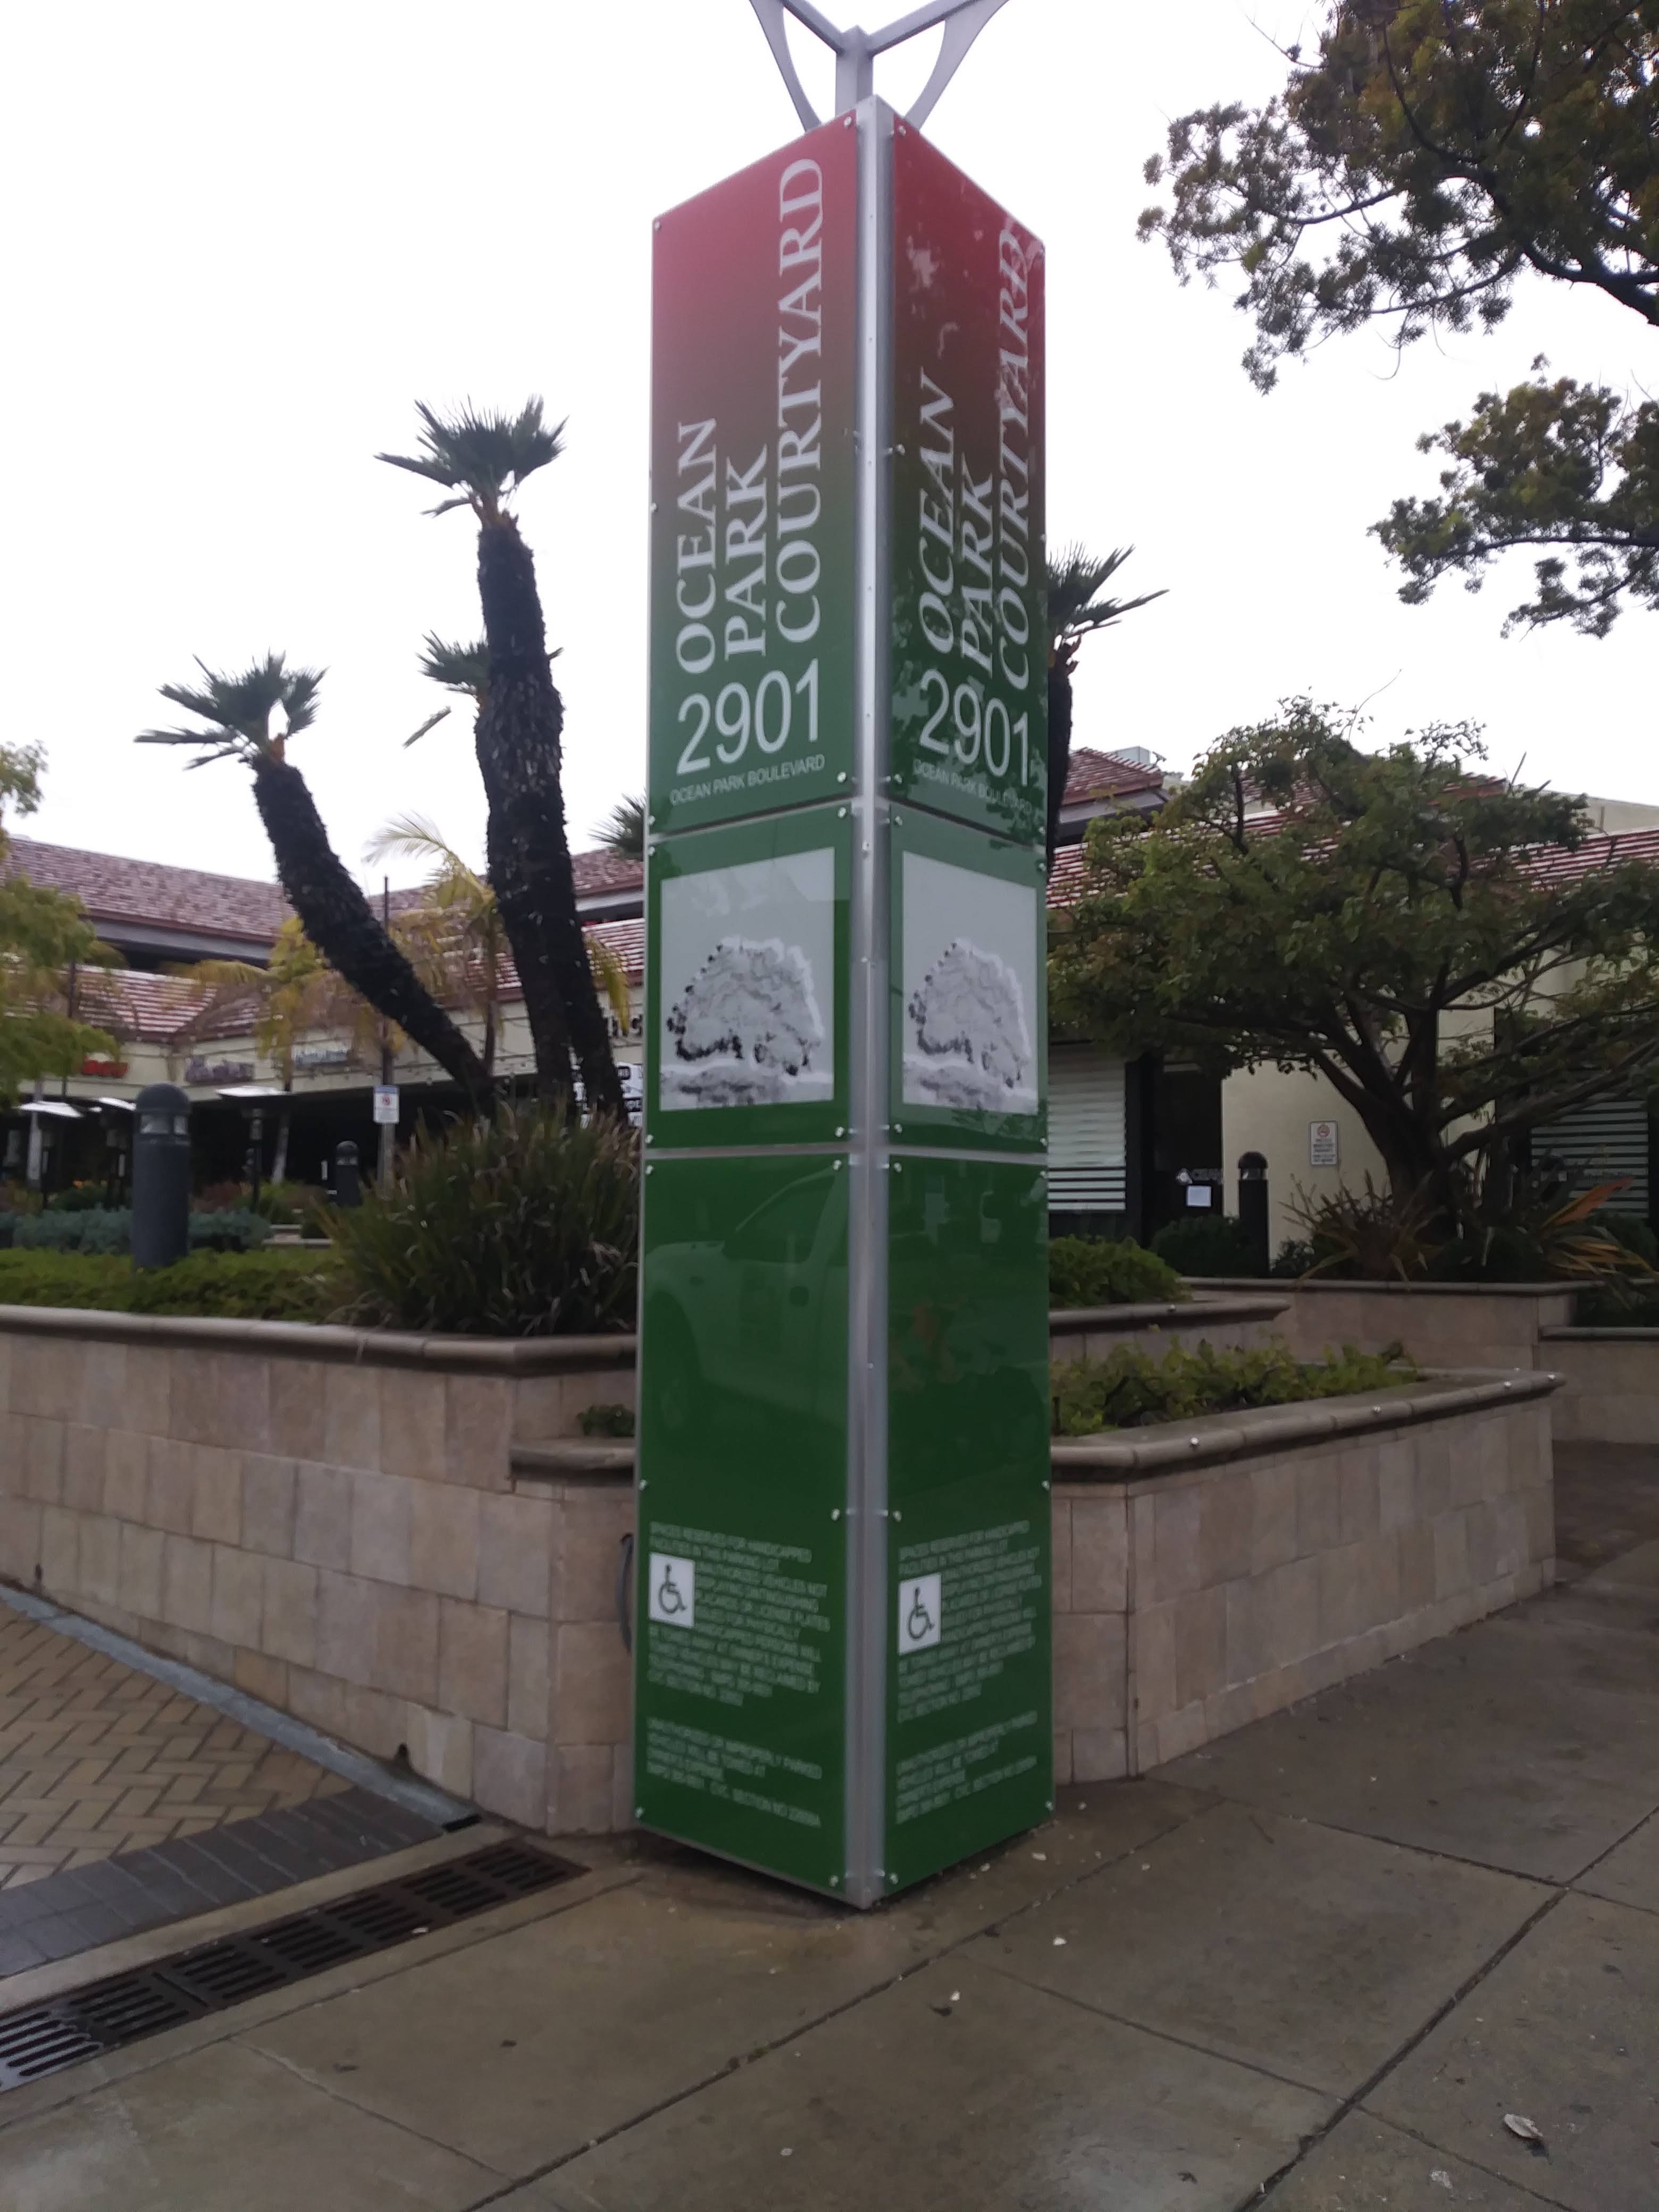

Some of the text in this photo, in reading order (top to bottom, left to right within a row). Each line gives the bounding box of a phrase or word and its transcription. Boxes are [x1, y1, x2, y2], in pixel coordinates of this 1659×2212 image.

[775, 158, 823, 643] COURTYARD
[919, 365, 954, 654] OCEAN
[998, 229, 1029, 691] COURTYARD
[676, 417, 717, 674] OCEAN
[724, 443, 768, 661] PARK
[961, 451, 993, 679] PARK
[669, 753, 825, 806] OCEAN PARK BOULEVARD
[676, 658, 819, 776] 2901
[920, 668, 1029, 787] 2901
